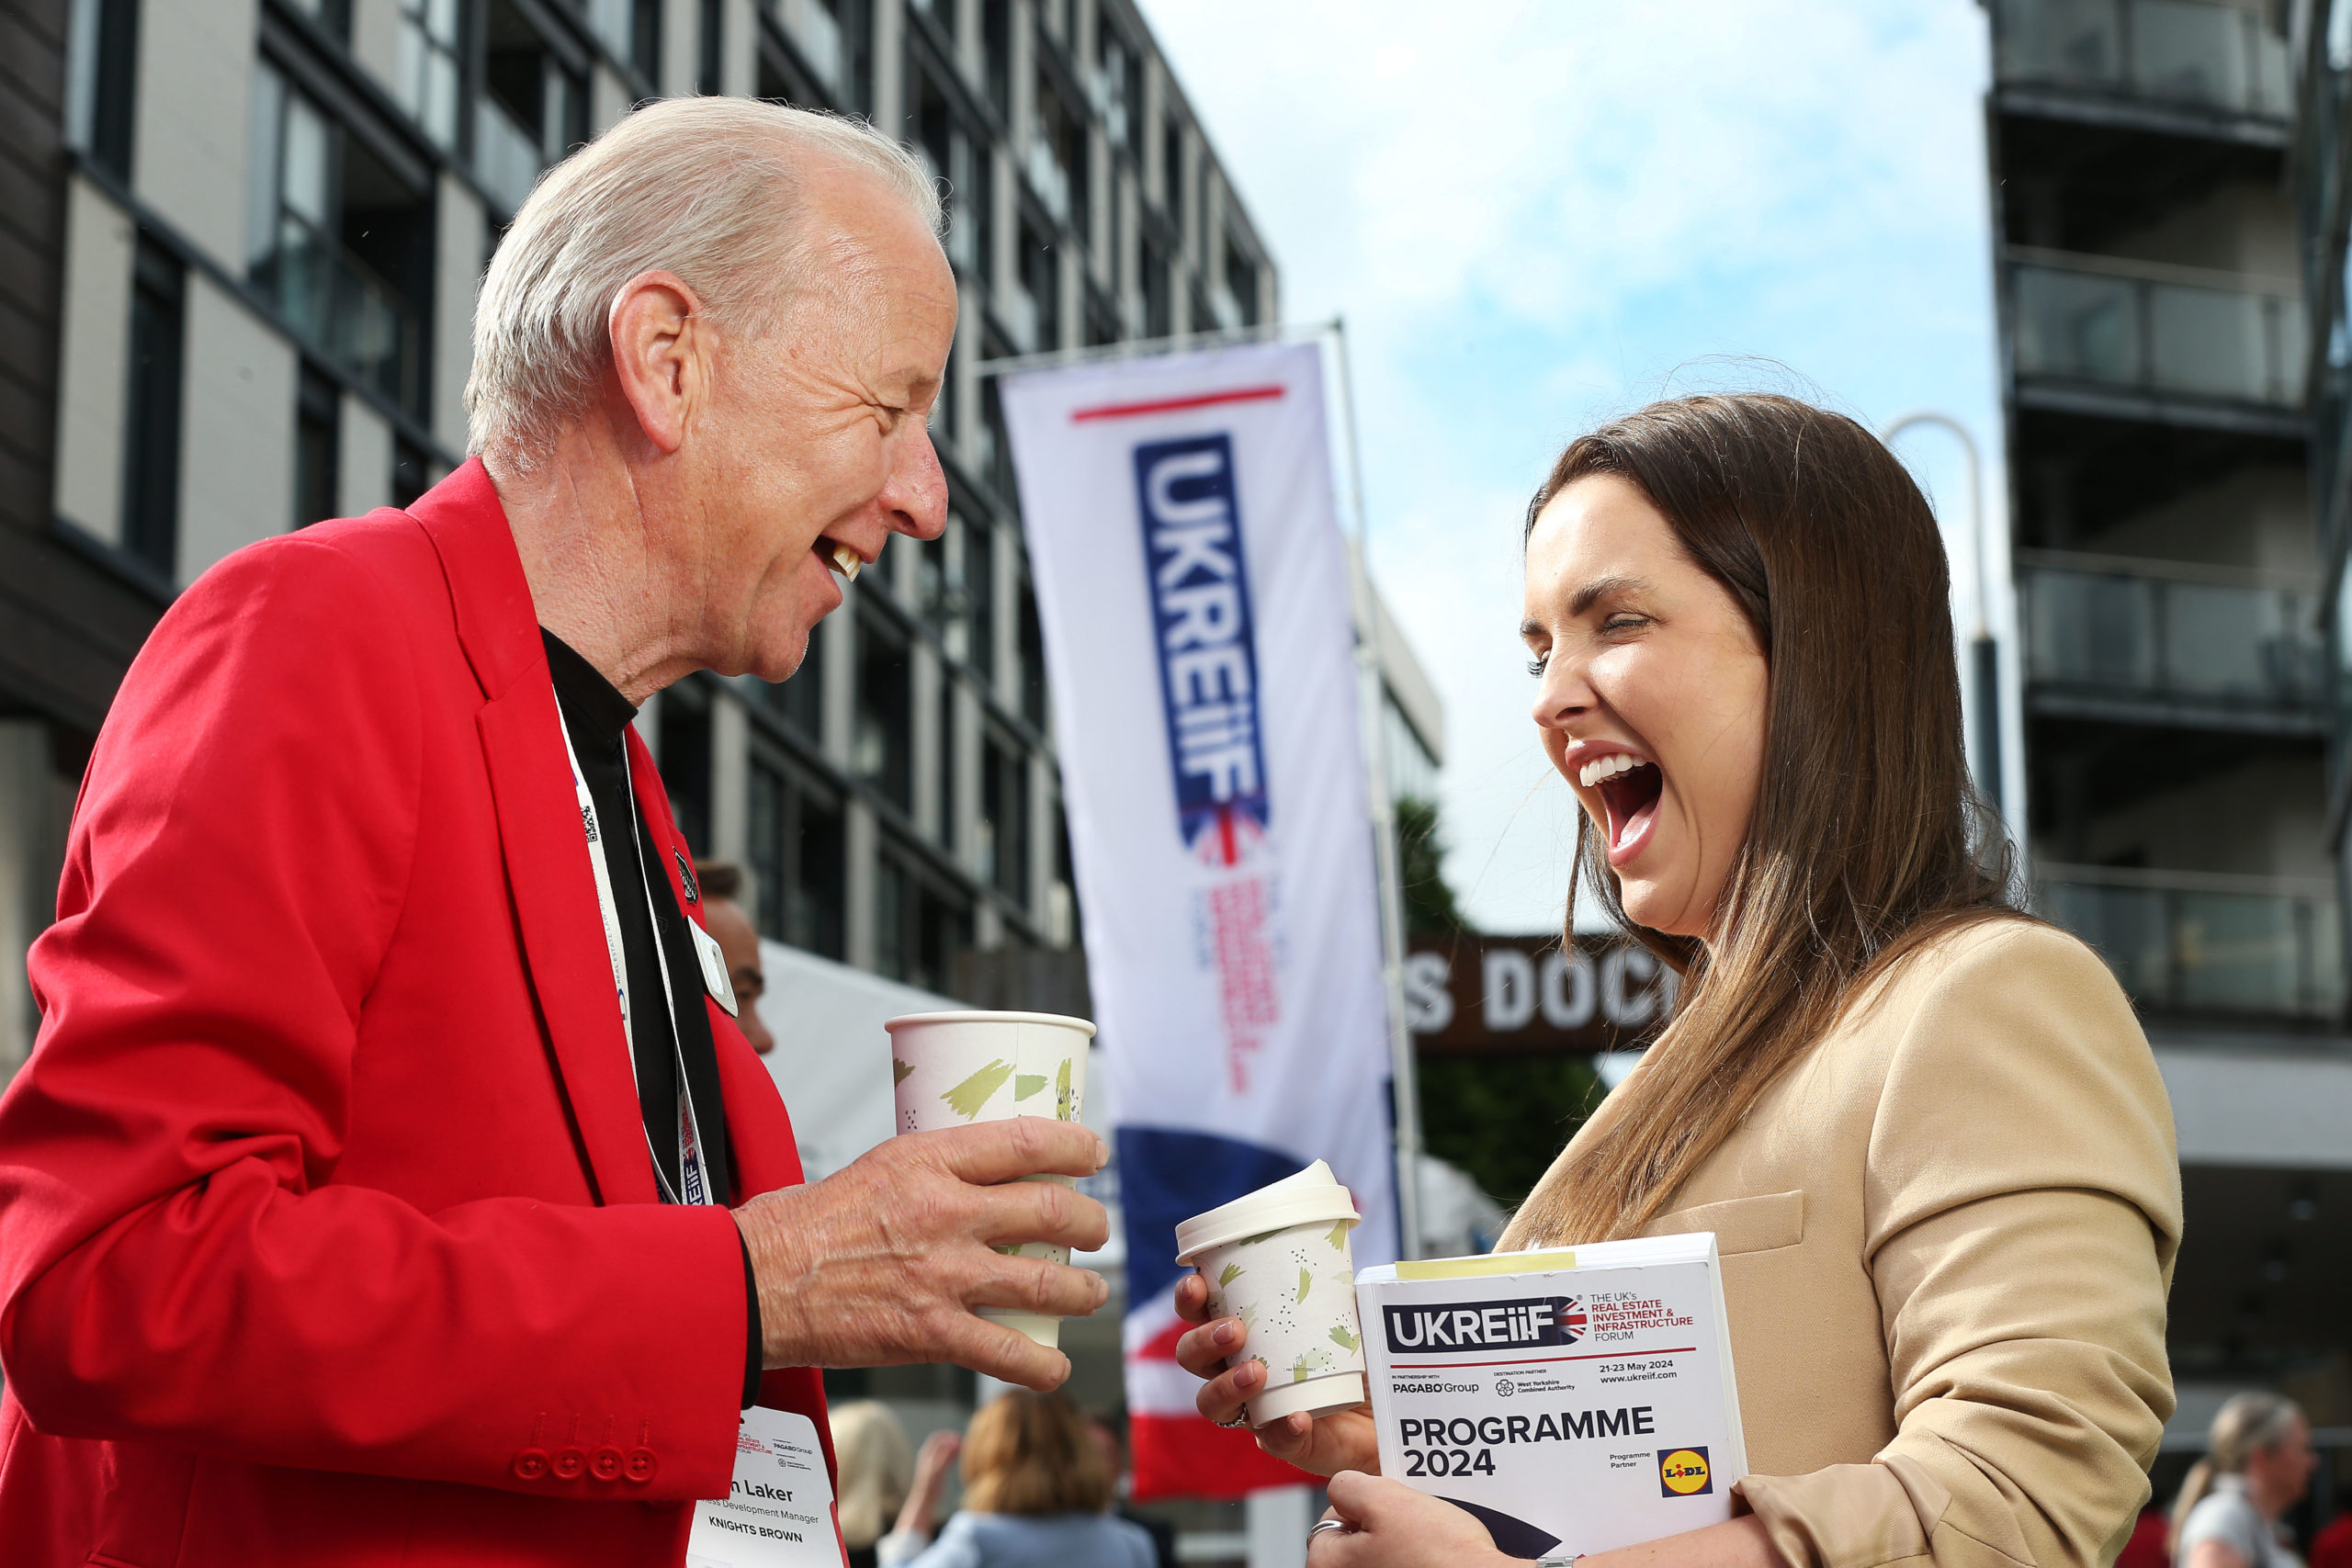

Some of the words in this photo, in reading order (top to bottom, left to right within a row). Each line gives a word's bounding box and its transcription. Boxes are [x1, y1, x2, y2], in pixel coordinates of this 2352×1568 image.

[1148, 449, 1258, 804] UKREiiF
[1589, 1292, 1611, 1303] THE
[1613, 1292, 1637, 1301] UK's
[1591, 1303, 1620, 1313] REAL
[1622, 1300, 1663, 1311] ESTATE
[1592, 1309, 1664, 1323] INVESTMENT
[1666, 1308, 1674, 1316] &
[1392, 1304, 1555, 1347] UKREiiF
[1594, 1316, 1694, 1332] INFRASTRUCTURE
[1595, 1331, 1634, 1342] FORUM
[1599, 1364, 1624, 1373] 21-23
[1627, 1362, 1646, 1372] May
[1649, 1359, 1674, 1369] 2024
[1535, 1379, 1560, 1387] Yorkshire
[1600, 1371, 1678, 1383] www.ukreiif.com
[1517, 1385, 1546, 1393] Combined
[1547, 1383, 1575, 1393] Authority
[1399, 1405, 1656, 1446] PROGRAMME
[1403, 1448, 1497, 1476] 2024
[1610, 1452, 1651, 1462] Programme
[1611, 1461, 1637, 1469] Partner
[744, 1479, 793, 1502] Laker
[722, 1499, 779, 1517] Development
[780, 1510, 819, 1524] Manager
[708, 1515, 757, 1535] KNIGHTS
[759, 1527, 803, 1543] BROWN
